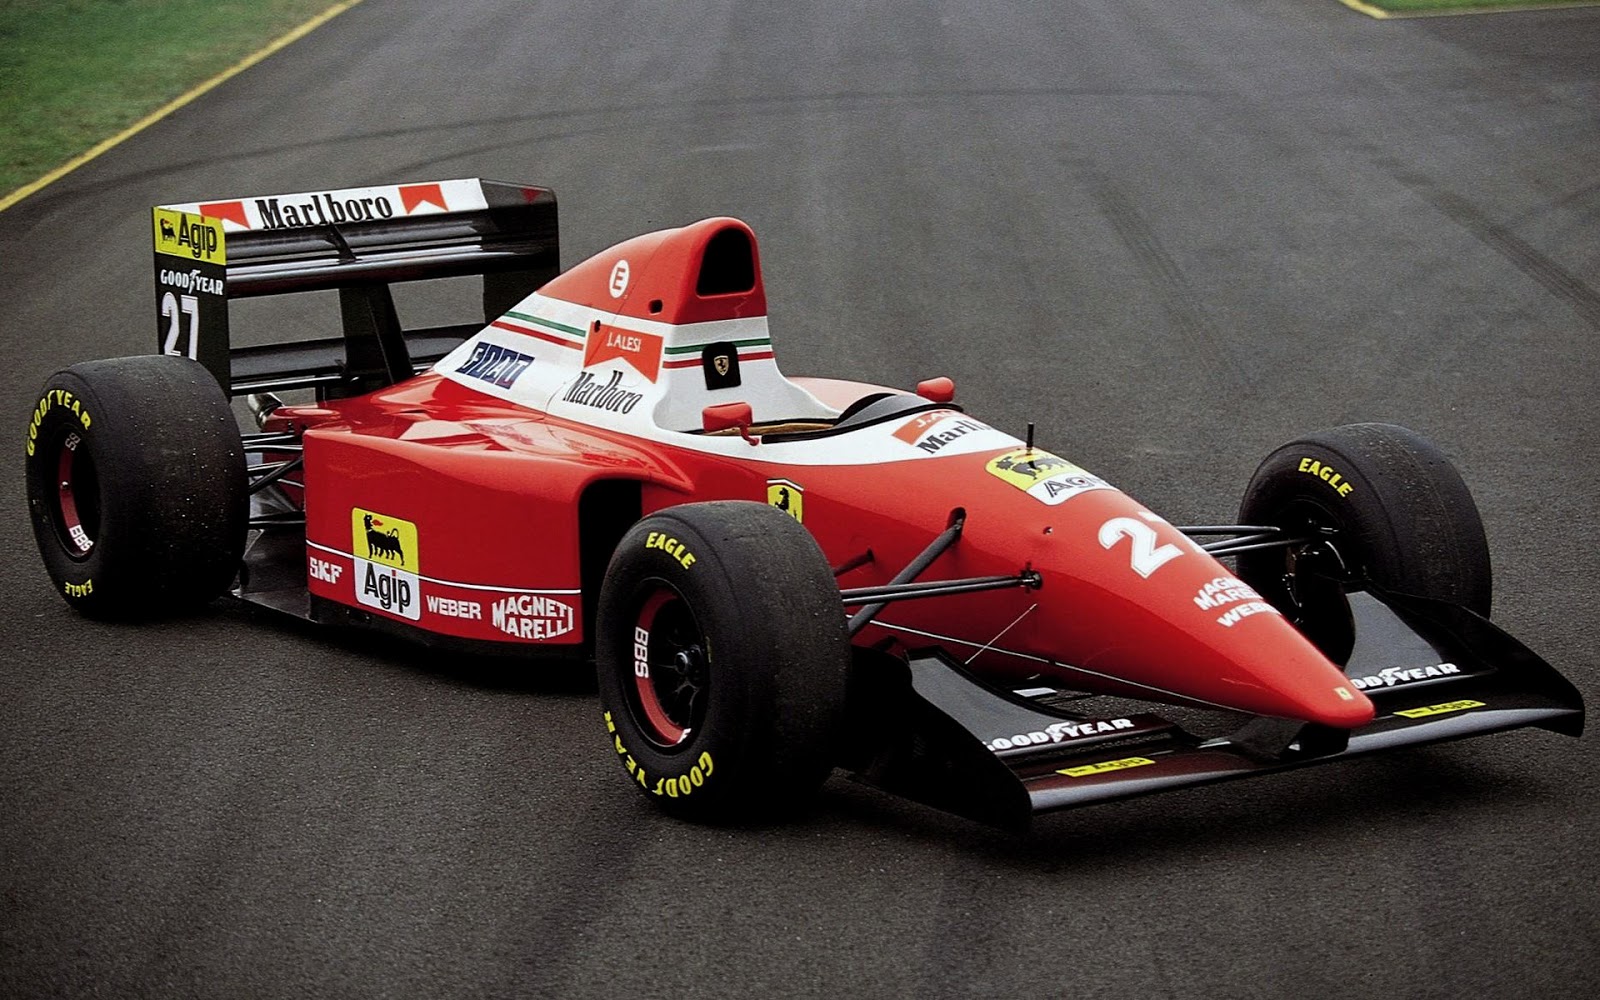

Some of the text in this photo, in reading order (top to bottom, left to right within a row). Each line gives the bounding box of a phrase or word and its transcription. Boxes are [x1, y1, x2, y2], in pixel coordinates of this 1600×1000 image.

[254, 193, 394, 230] Marlboro
[178, 213, 218, 260] Agip
[160, 268, 224, 296] GOODYEAR
[611, 265, 627, 291] E
[161, 291, 200, 361] 27
[461, 346, 530, 386] FIAT
[562, 370, 643, 415] Marlboro
[27, 389, 91, 457] GOODYEAR
[1298, 457, 1354, 498] EAGLE
[309, 556, 343, 585] SKF
[645, 532, 697, 570] EAGLE
[64, 577, 94, 598] EAGLE
[364, 562, 411, 614] Agip
[426, 595, 482, 620] WEBER
[634, 626, 650, 679] BBS
